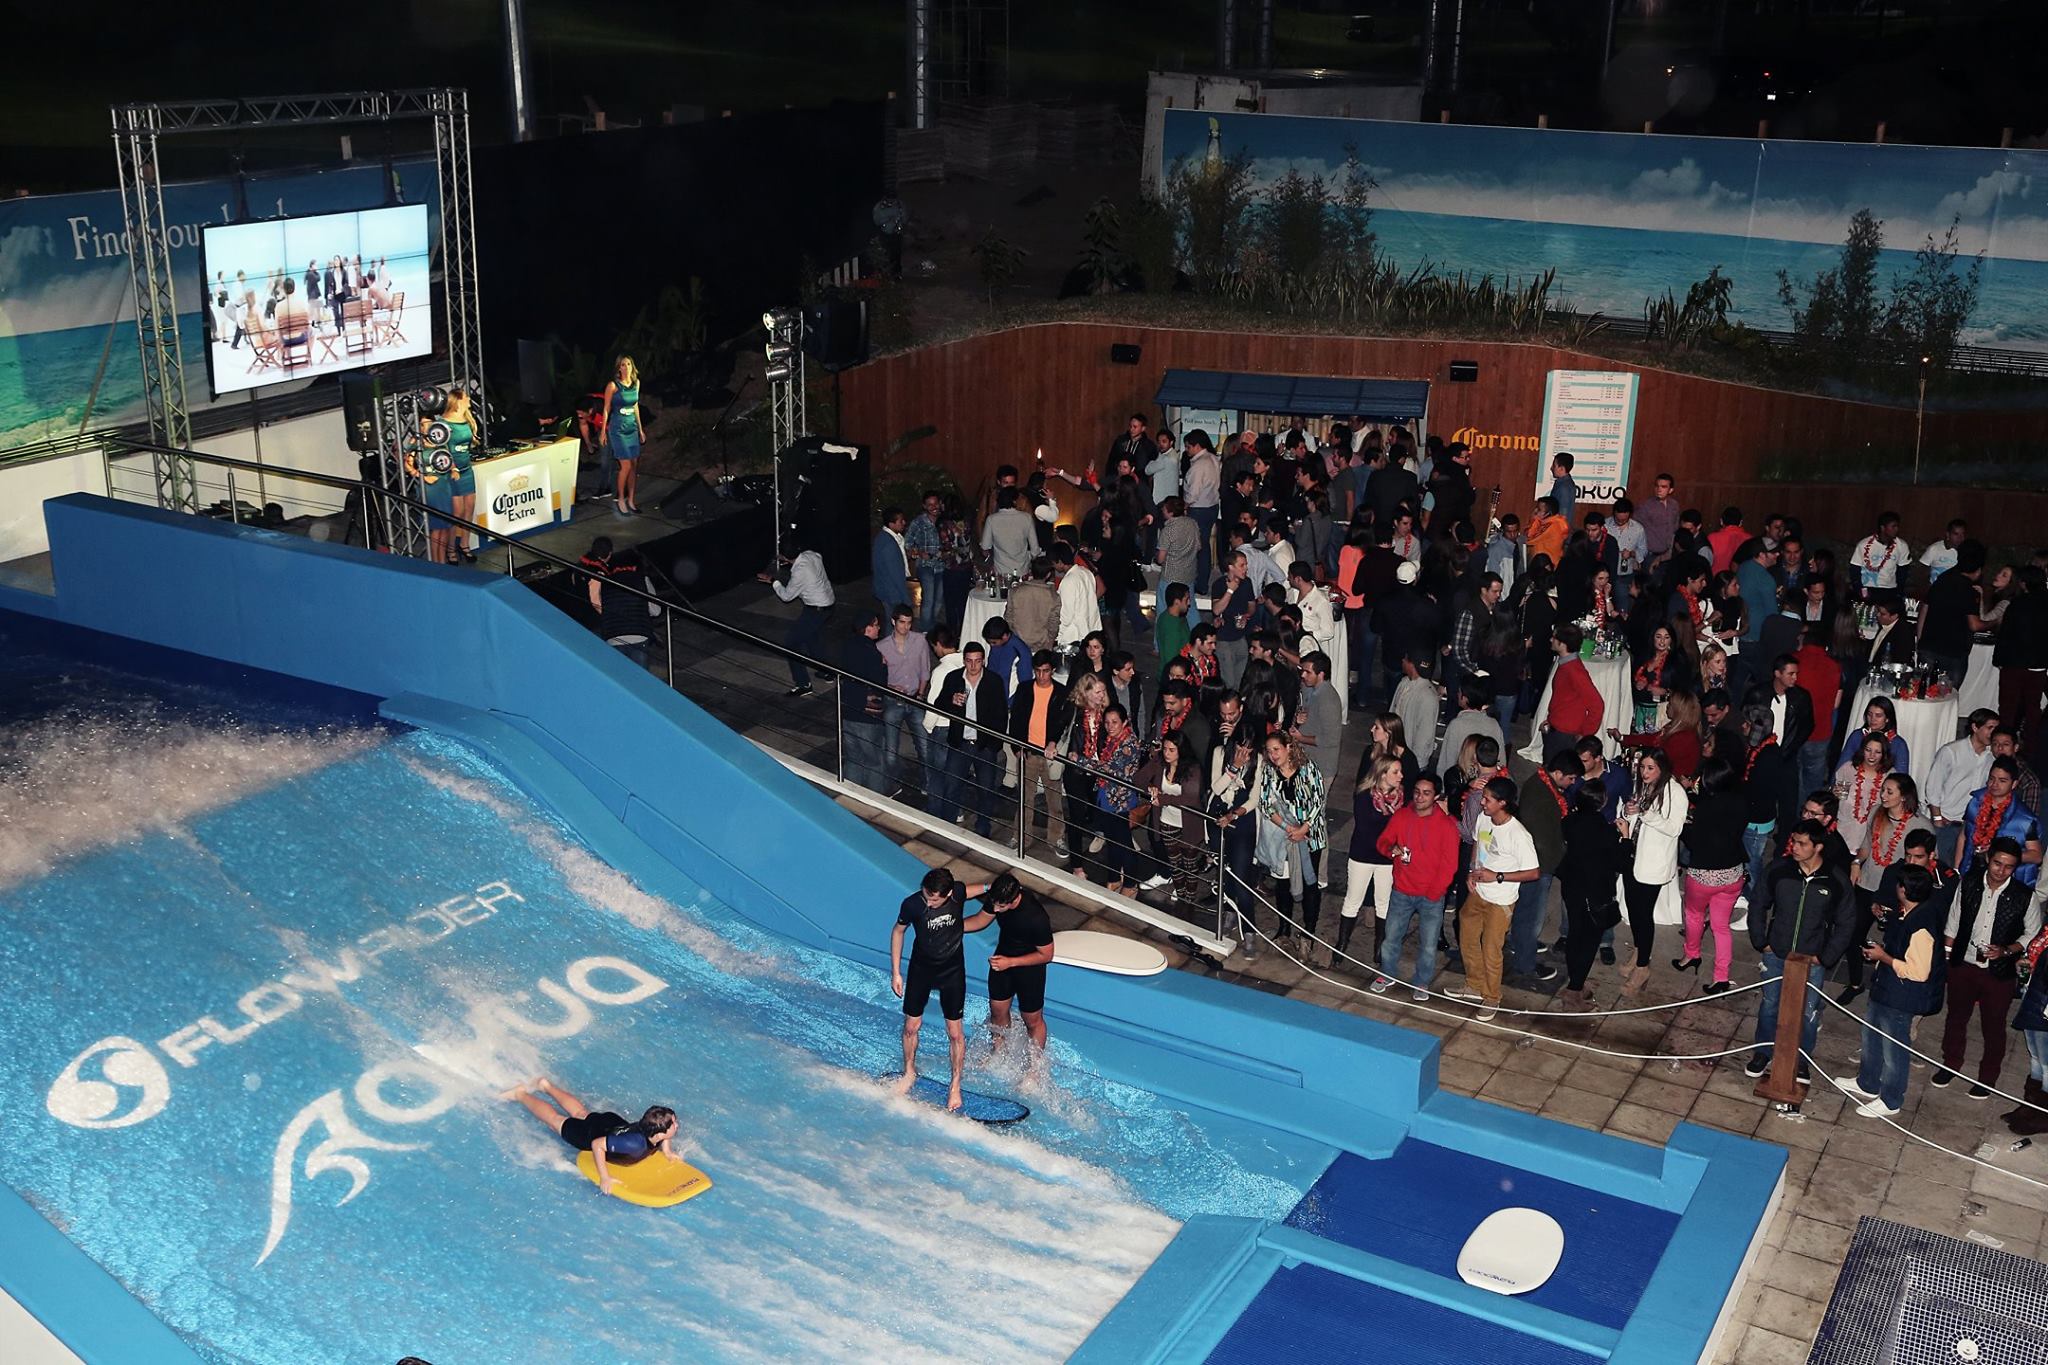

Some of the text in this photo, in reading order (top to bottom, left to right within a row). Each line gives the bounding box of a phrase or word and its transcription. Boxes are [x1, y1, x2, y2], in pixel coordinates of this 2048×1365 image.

[1451, 427, 1539, 453] Corona
[492, 487, 544, 515] Corona
[508, 507, 536, 522] Extra
[157, 879, 525, 1068] FLOWRDER
